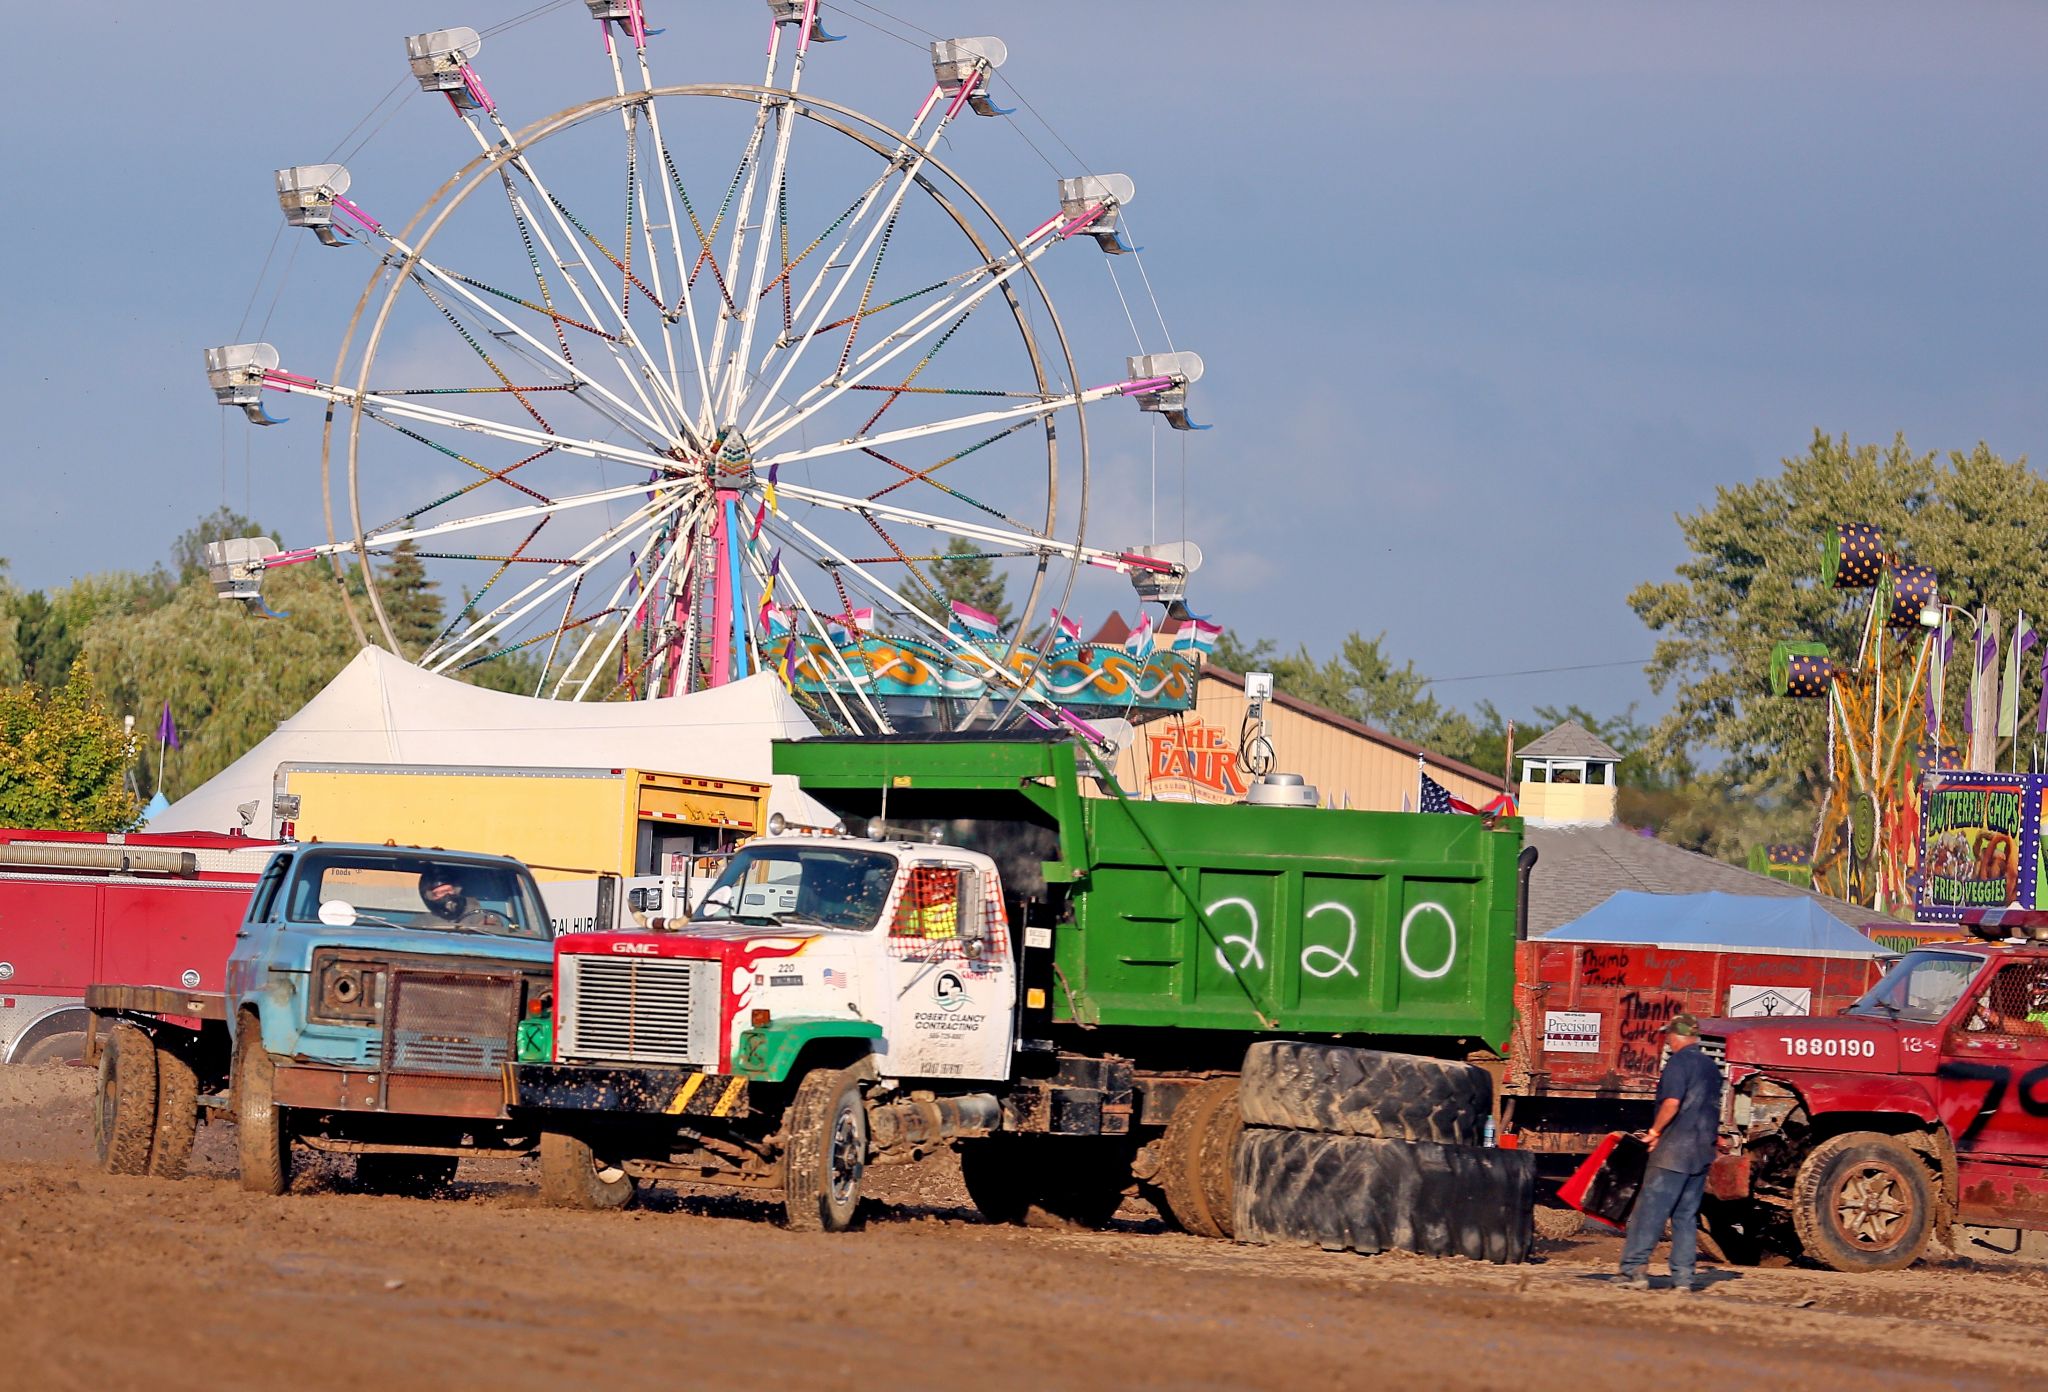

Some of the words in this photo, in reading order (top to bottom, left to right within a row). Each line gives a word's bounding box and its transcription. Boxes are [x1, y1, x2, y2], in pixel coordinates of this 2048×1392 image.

[1167, 720, 1228, 748] THE
[1148, 735, 1248, 794] FAIR
[1929, 791, 1986, 836] BUTTERFLY
[1986, 792, 2019, 838] CHIPS
[1934, 875, 1964, 904] FRIED
[1964, 879, 2006, 904] VEGGIES
[1205, 897, 1457, 978] 220
[612, 942, 659, 954] GMC
[1583, 948, 1629, 968] Thumb
[778, 963, 795, 973] 220
[1584, 969, 1627, 987] Truck
[914, 1012, 948, 1021] ROBERT
[949, 1014, 986, 1022] CLANCY
[915, 1021, 980, 1032] CONTRACTING
[1548, 1018, 1598, 1033] Precision
[1780, 1037, 1876, 1057] 7880190
